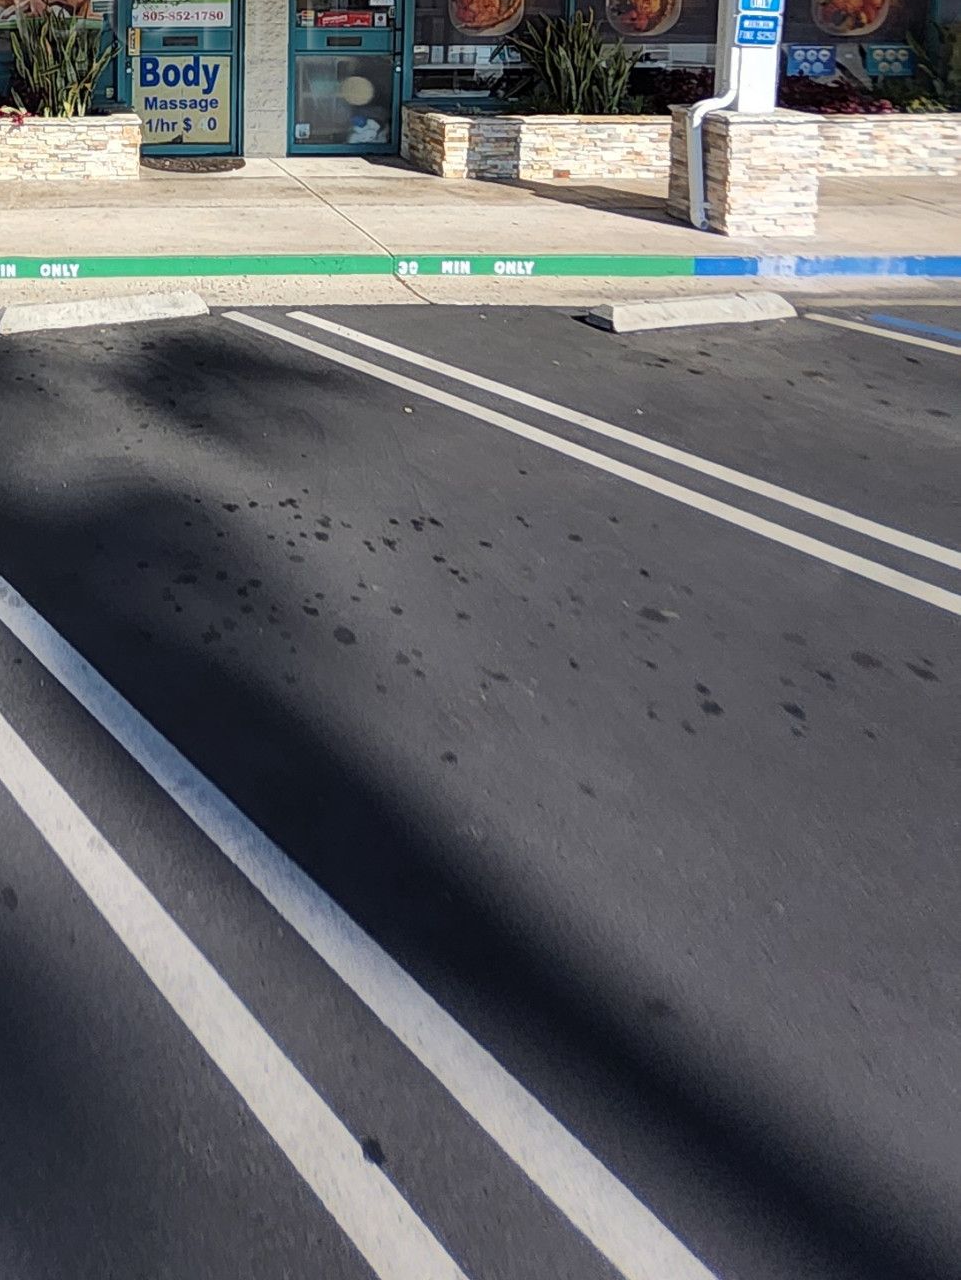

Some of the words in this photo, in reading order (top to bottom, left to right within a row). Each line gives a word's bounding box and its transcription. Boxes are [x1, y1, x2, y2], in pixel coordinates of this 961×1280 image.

[142, 10, 224, 21] 805-852-1780
[140, 54, 220, 95] Body
[144, 97, 219, 113] Massage
[145, 118, 178, 133] 1/hr
[40, 264, 79, 278] ONLY
[396, 261, 419, 275] 30
[441, 261, 471, 275] MIN
[493, 261, 535, 275] ONLY
